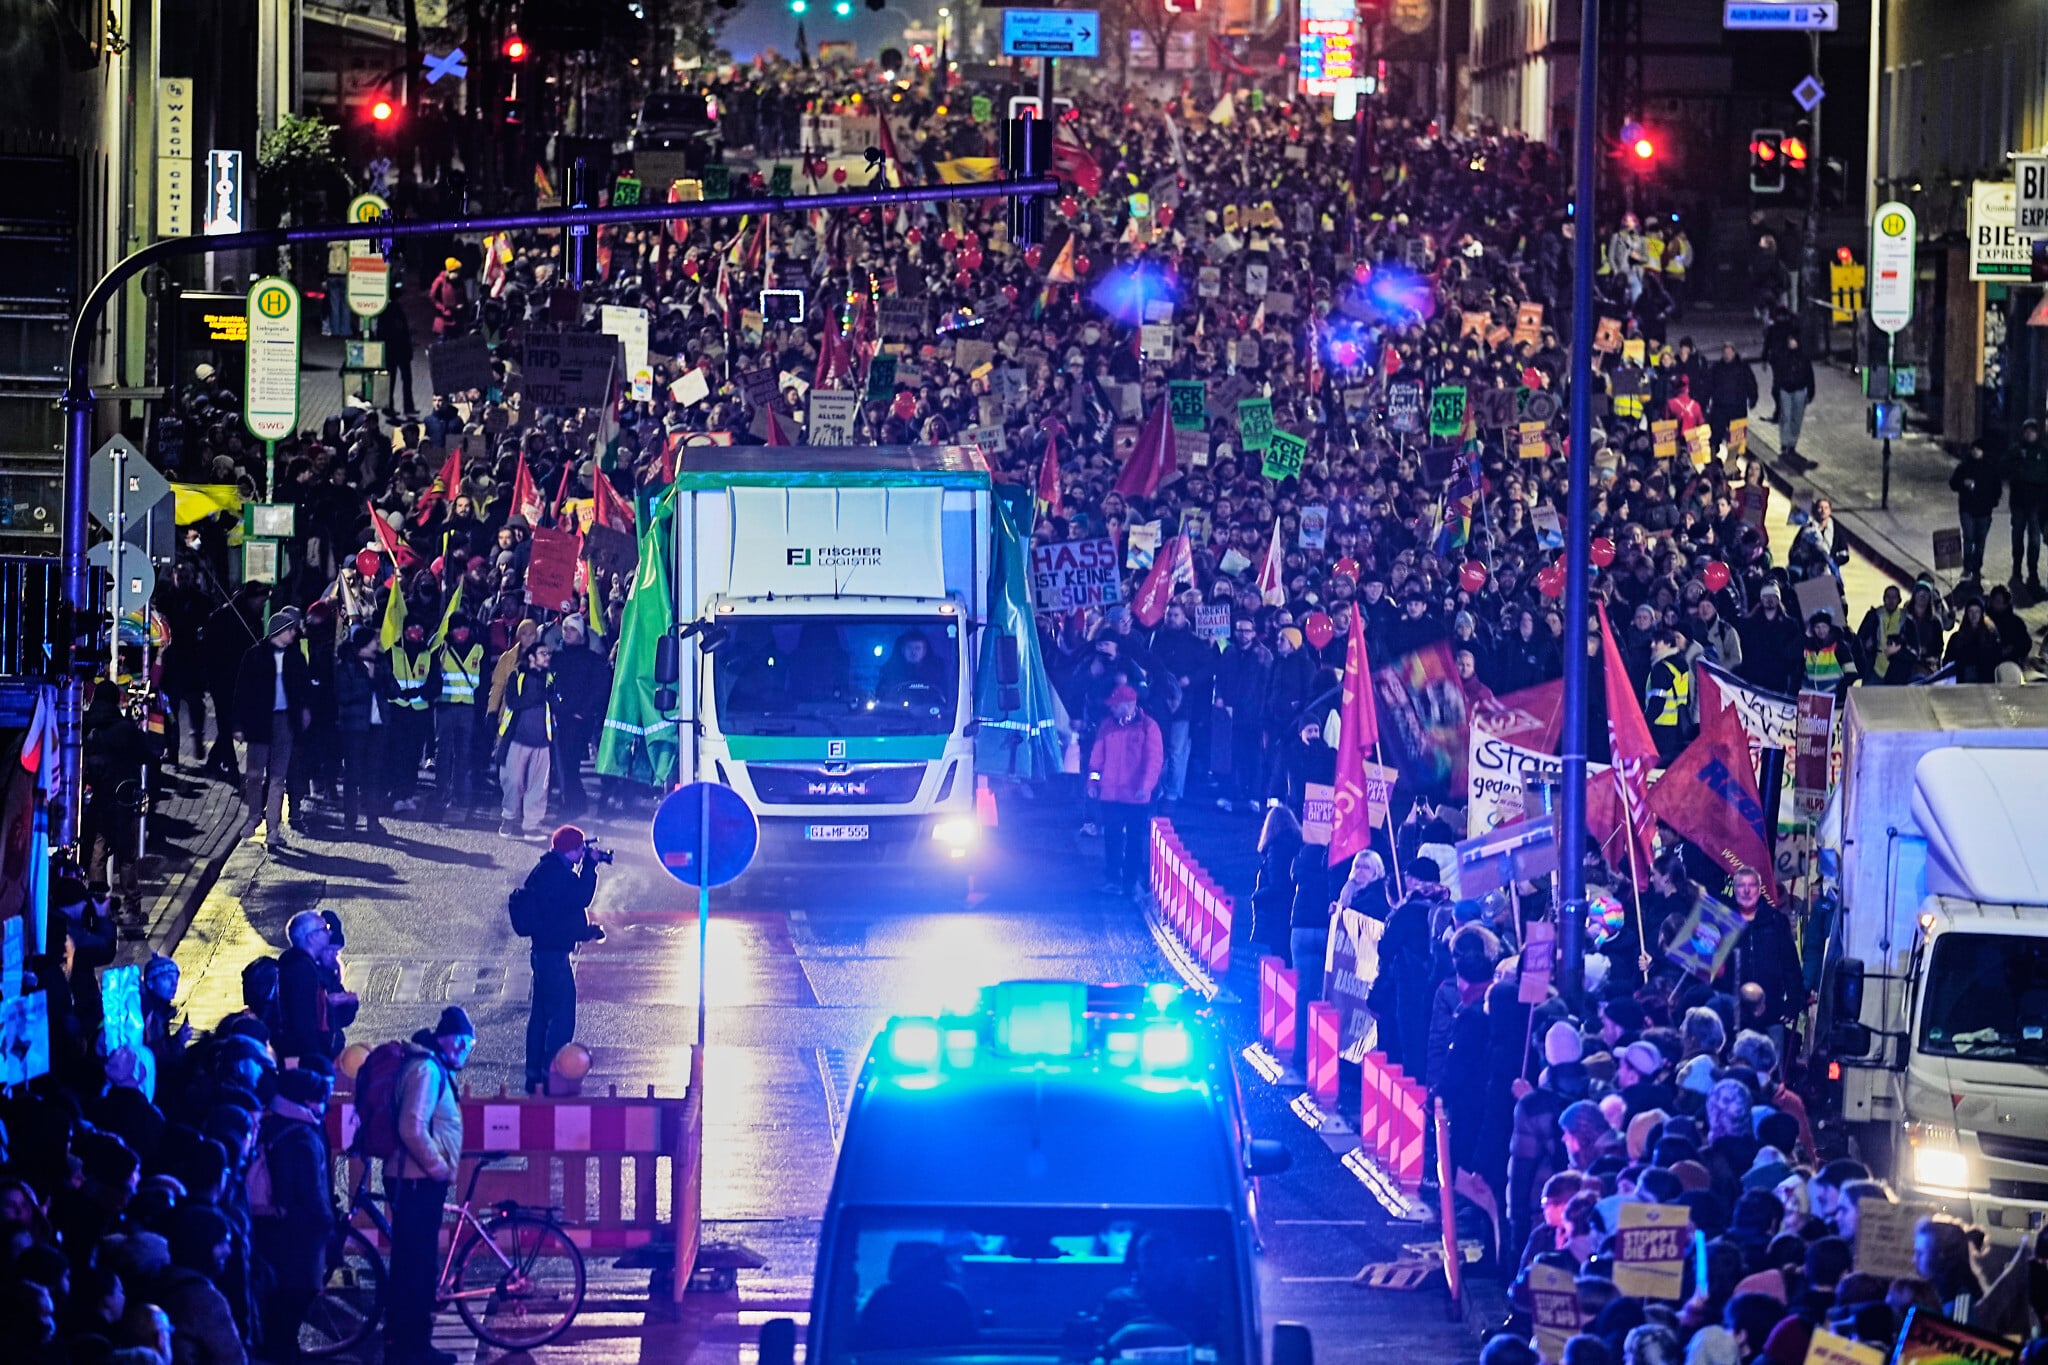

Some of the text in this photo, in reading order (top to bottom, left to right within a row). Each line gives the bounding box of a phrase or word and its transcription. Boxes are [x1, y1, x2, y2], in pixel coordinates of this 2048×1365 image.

[2024, 166, 2048, 200] BI
[215, 152, 235, 233] KIOS
[1171, 387, 1202, 401] FCK
[1434, 393, 1463, 406] FCK
[1171, 402, 1203, 415] AFD
[1241, 404, 1270, 419] FCK
[1433, 407, 1464, 420] AFD
[258, 422, 285, 430] SWG
[1242, 419, 1273, 433] AFD
[1271, 437, 1304, 457] FCK
[1267, 451, 1300, 469] AFD
[818, 547, 881, 556] FISCHER
[1031, 540, 1117, 574] HASS
[818, 557, 881, 566] LOGISTIK
[1034, 568, 1115, 589] IST KEINE
[808, 782, 866, 796] MAN
[1473, 777, 1522, 804] gegen
[1308, 801, 1335, 813] STOPP
[1623, 1229, 1677, 1245] STOPPT
[1623, 1245, 1646, 1260] DIE
